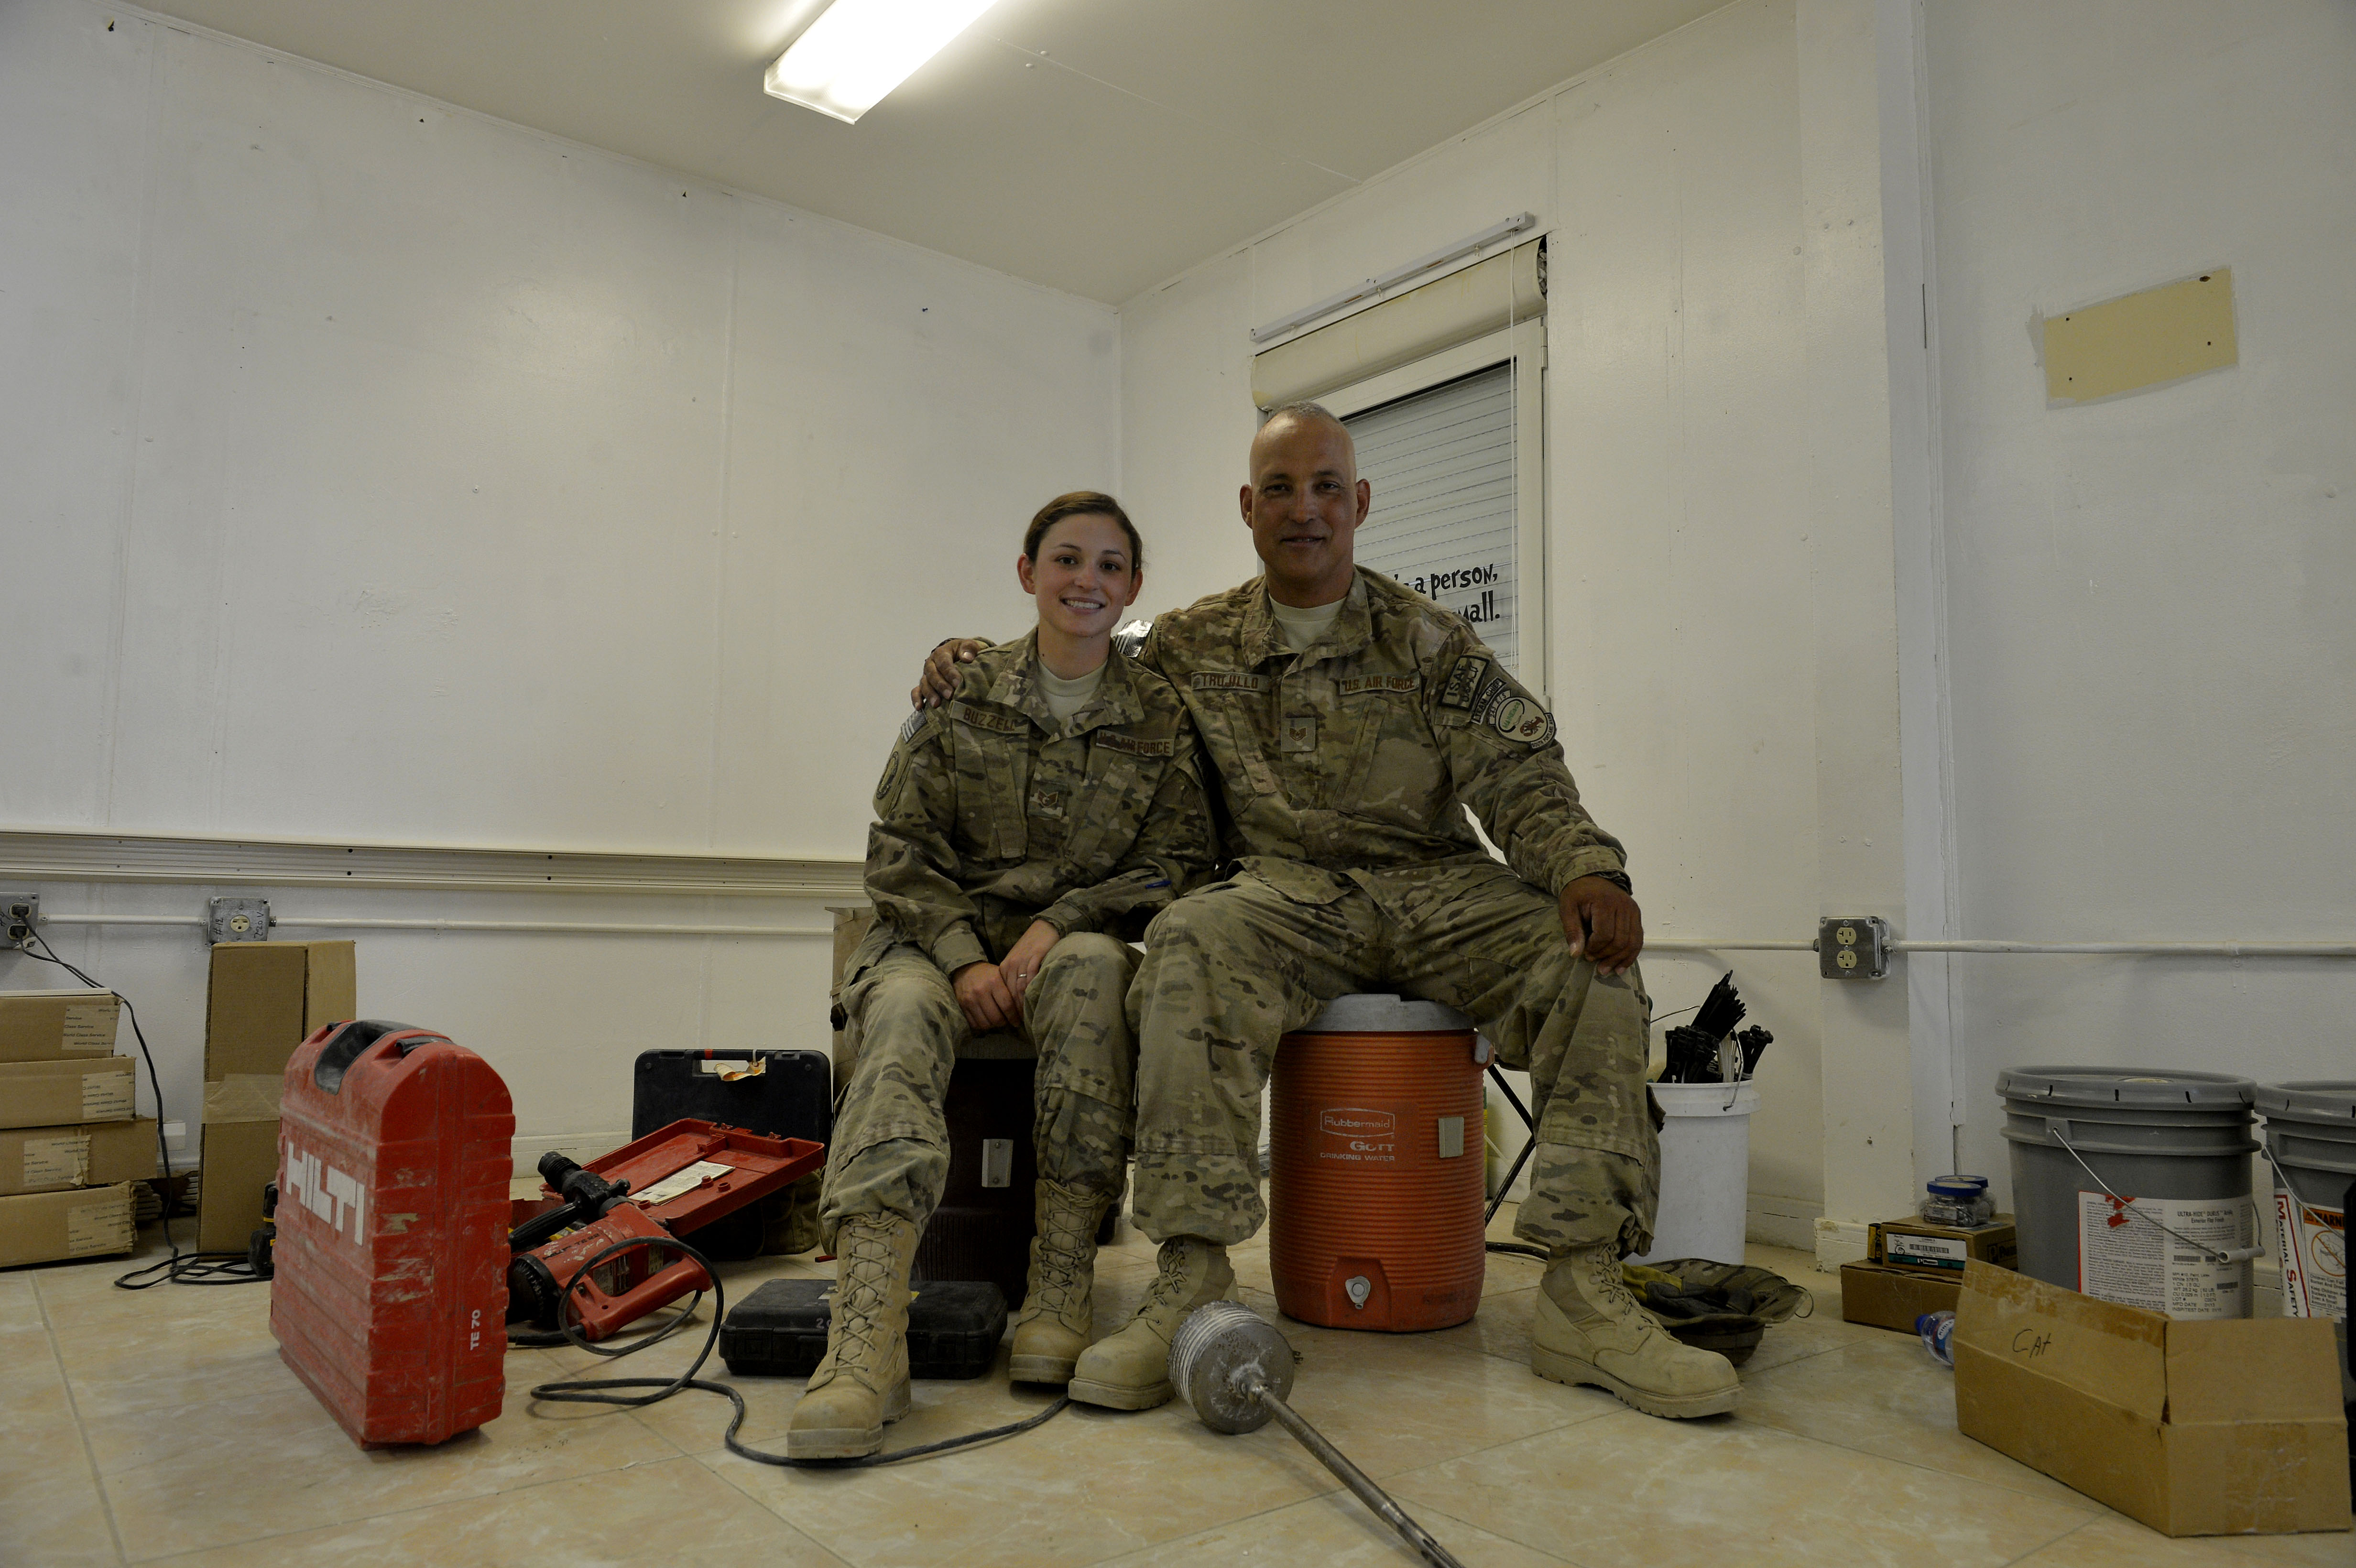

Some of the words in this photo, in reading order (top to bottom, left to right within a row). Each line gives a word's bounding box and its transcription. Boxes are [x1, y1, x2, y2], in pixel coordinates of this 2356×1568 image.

[1415, 577, 1427, 594] a
[1430, 563, 1498, 600] person,
[1458, 590, 1500, 622] mall.
[1201, 673, 1259, 689] TRUJILLO
[1364, 675, 1383, 688] AIR
[1386, 675, 1415, 690] FORCE
[1447, 664, 1466, 697] ISAF
[1474, 698, 1488, 719] TEAM
[1486, 680, 1502, 697] CHIEF
[963, 707, 1014, 731] BUZZELL
[1137, 741, 1170, 754] FORCE
[1325, 1116, 1390, 1128] Rubbermaid
[1320, 1152, 1361, 1160] DRINKING
[286, 1141, 365, 1247] HILTI
[2316, 1211, 2345, 1228] WARN
[2277, 1201, 2290, 1264] MATERIAL
[2286, 1269, 2299, 1318] SAFETY
[471, 1308, 481, 1329] 70
[469, 1331, 480, 1351] TE
